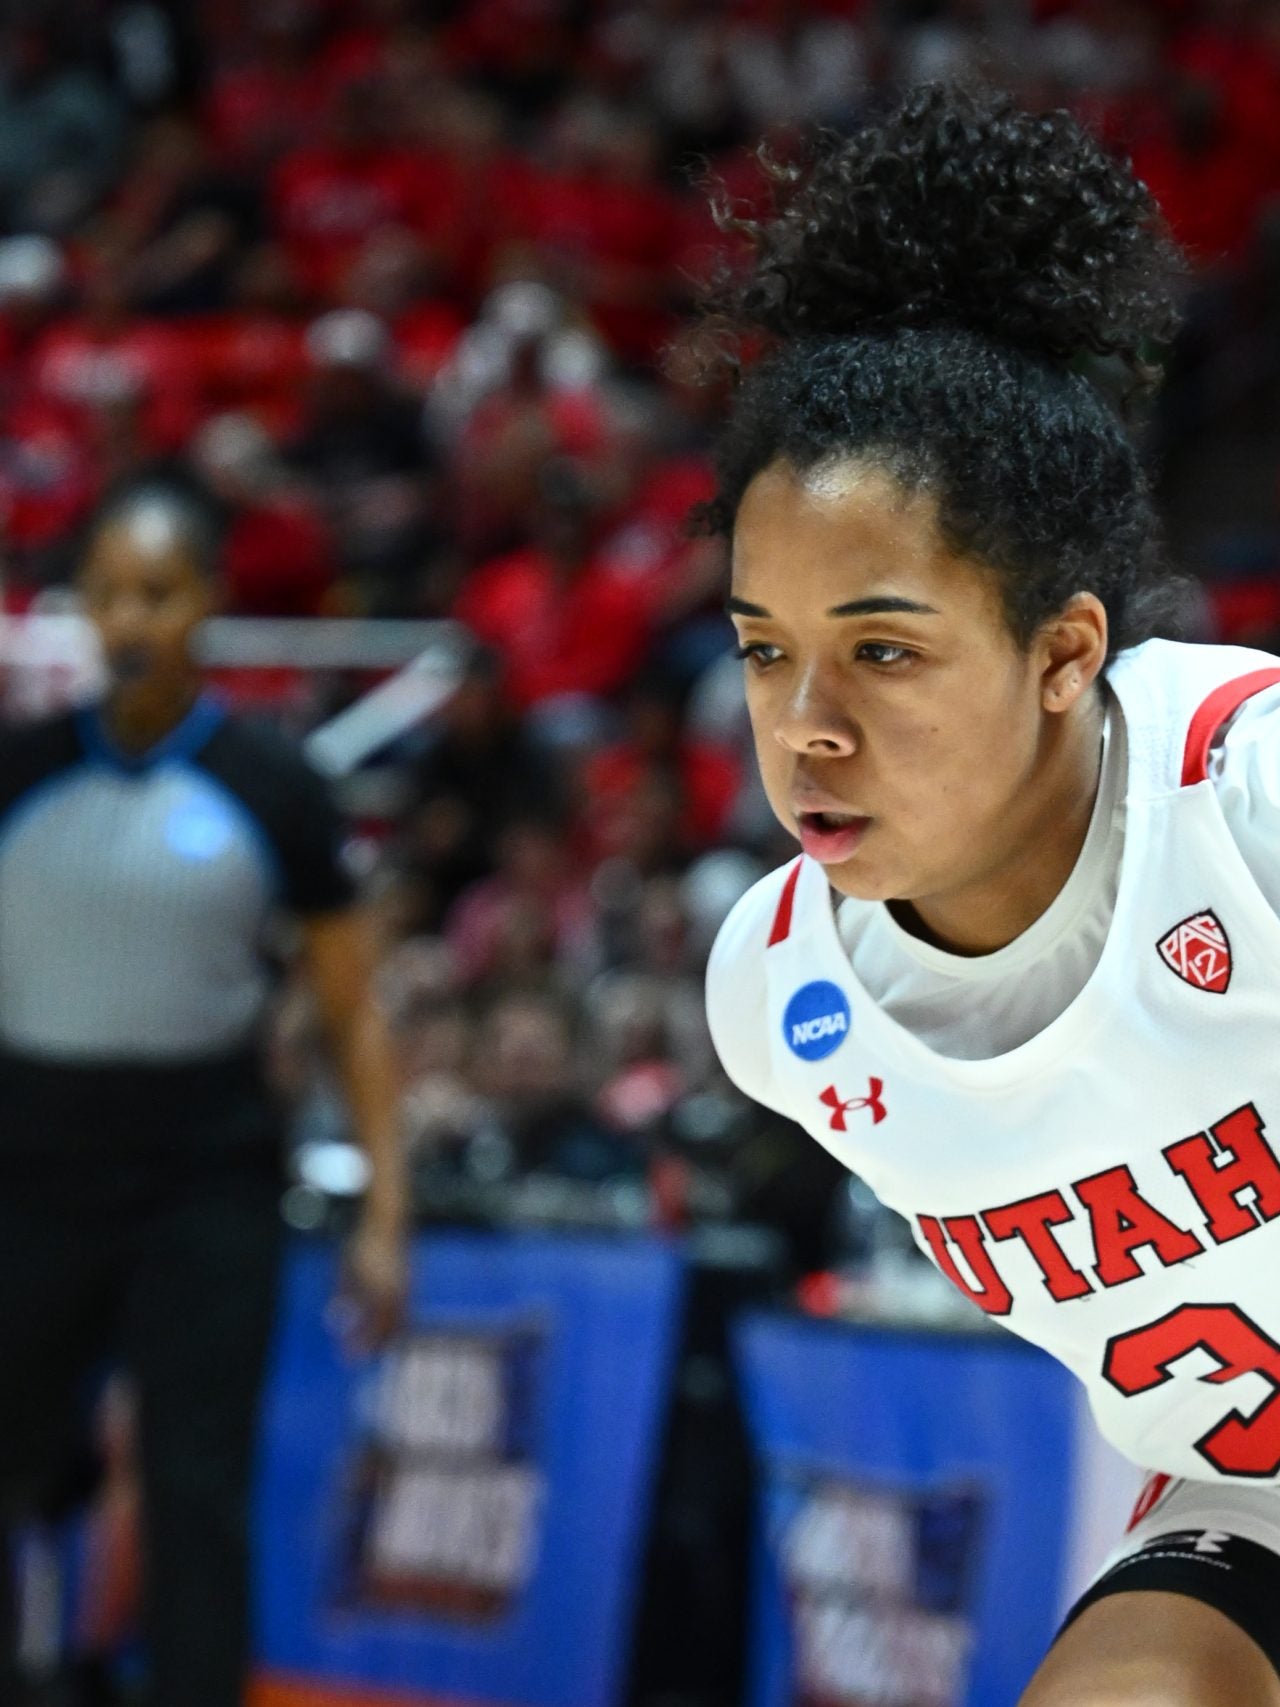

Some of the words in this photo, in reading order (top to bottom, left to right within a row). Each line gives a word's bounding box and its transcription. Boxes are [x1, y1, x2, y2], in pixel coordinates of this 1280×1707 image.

[1159, 914, 1228, 979] PAC
[1187, 948, 1228, 986] 12
[792, 1011, 848, 1046] NCAA
